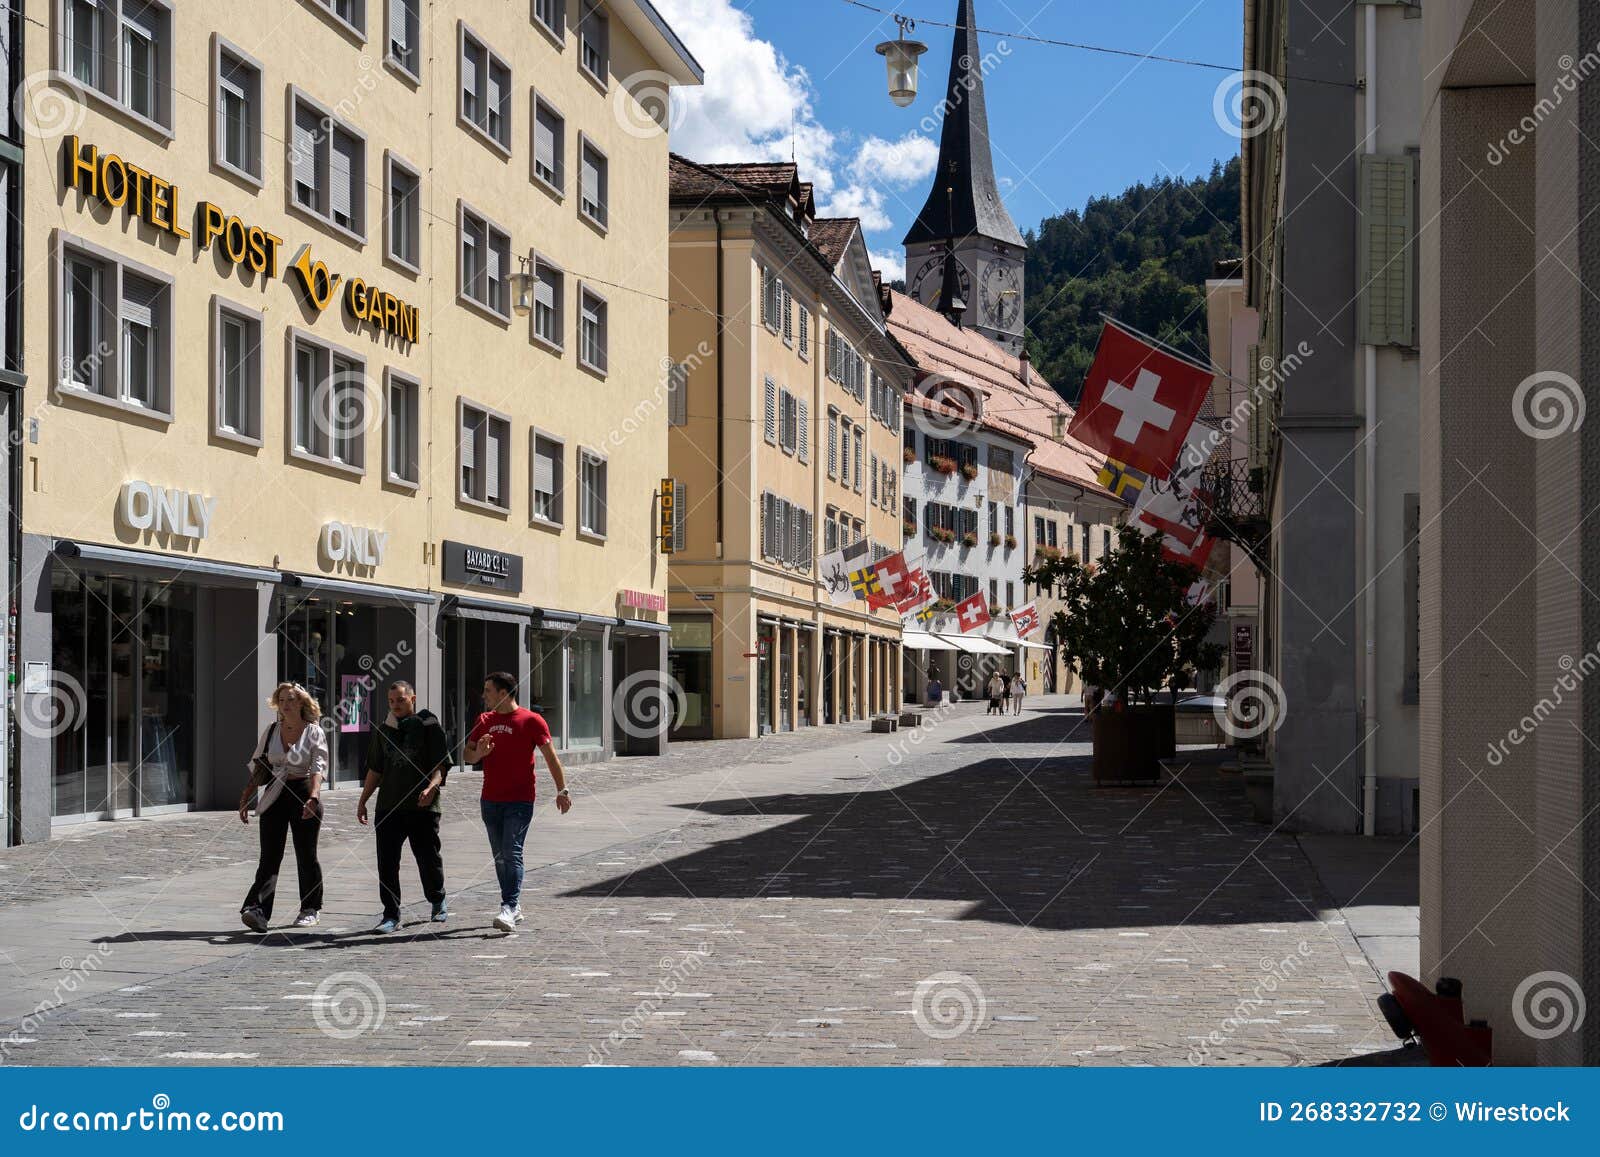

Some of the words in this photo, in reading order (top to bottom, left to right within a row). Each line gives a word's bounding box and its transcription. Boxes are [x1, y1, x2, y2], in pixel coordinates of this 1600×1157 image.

[65, 135, 190, 239] HOTEL
[198, 202, 283, 278] POST
[348, 277, 420, 344] GARNI
[120, 480, 217, 539] ONLY
[661, 480, 673, 552] HOTEL
[322, 520, 389, 567] ONLY
[466, 549, 491, 568] BAYARD
